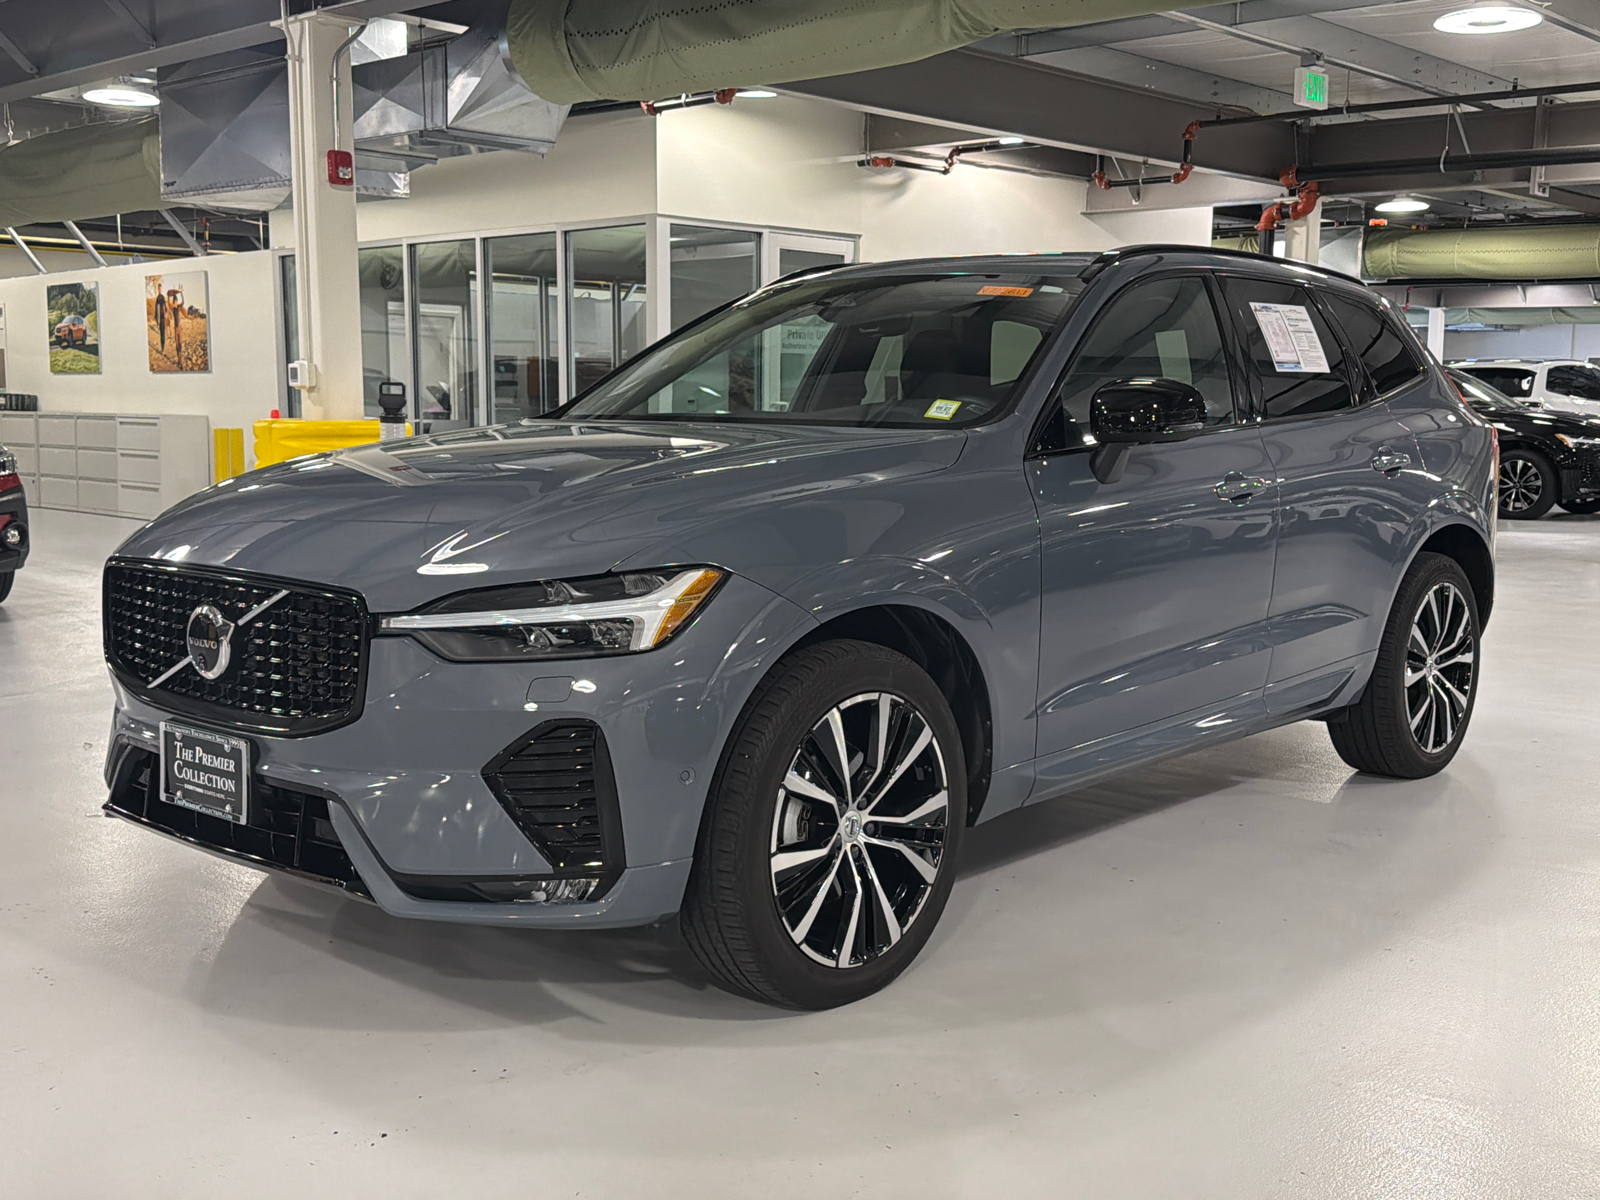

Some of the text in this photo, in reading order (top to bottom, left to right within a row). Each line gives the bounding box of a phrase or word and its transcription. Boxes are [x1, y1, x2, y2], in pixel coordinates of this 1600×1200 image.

[1306, 72, 1325, 103] EXIT
[787, 329, 815, 340] Private
[189, 636, 218, 650] VOLVO
[174, 741, 235, 772] THE PREMIER
[174, 760, 236, 793] COLLECTION
